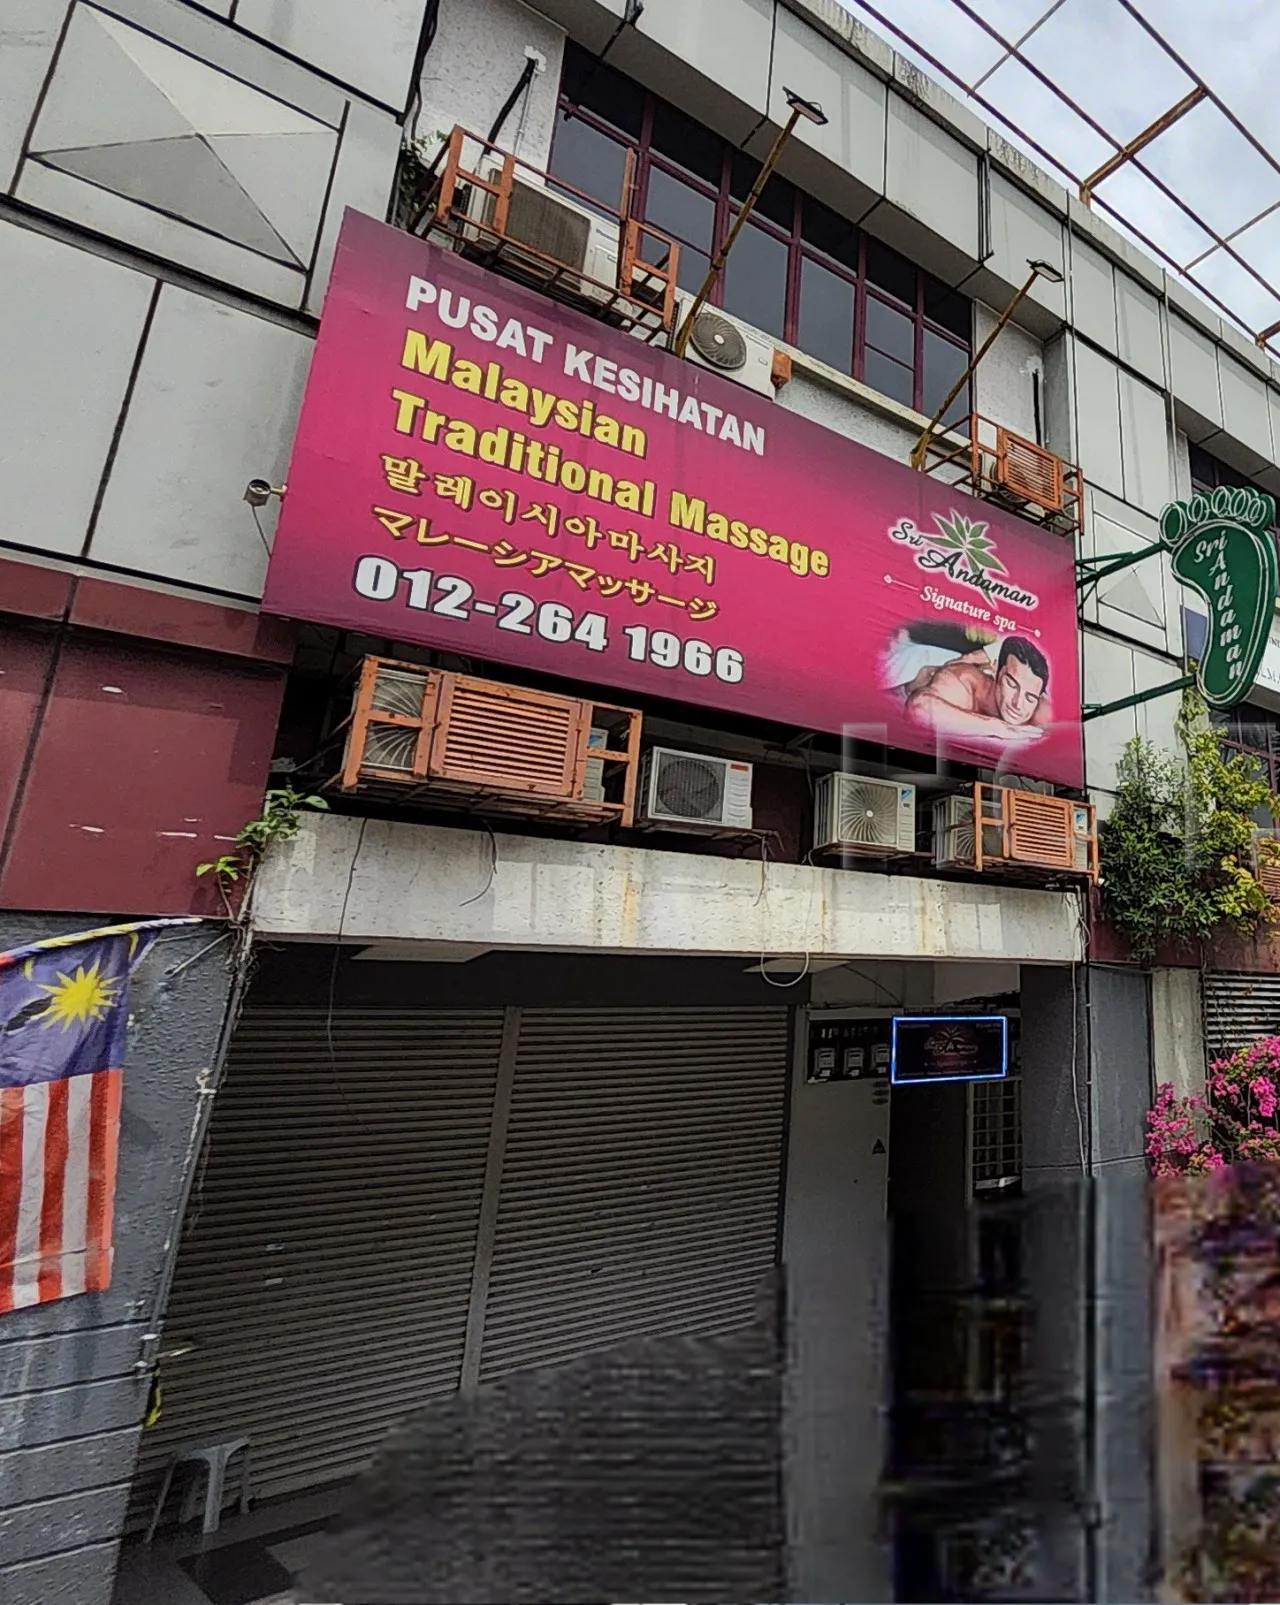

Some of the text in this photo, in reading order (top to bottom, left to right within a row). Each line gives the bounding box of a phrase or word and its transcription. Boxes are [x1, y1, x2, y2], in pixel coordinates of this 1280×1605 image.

[400, 329, 648, 460] Malaysian
[406, 275, 765, 456] PUSAT KESIHATAN
[392, 390, 831, 578] Traditional Massage
[892, 521, 924, 546] Sri
[372, 506, 719, 620] マレーシアマッサージ
[918, 549, 1036, 607] Andaman
[1194, 530, 1228, 563] Sri
[354, 555, 745, 686] 012-264 1966
[920, 585, 1017, 631] Signature spa
[1208, 551, 1243, 680] Andaman
